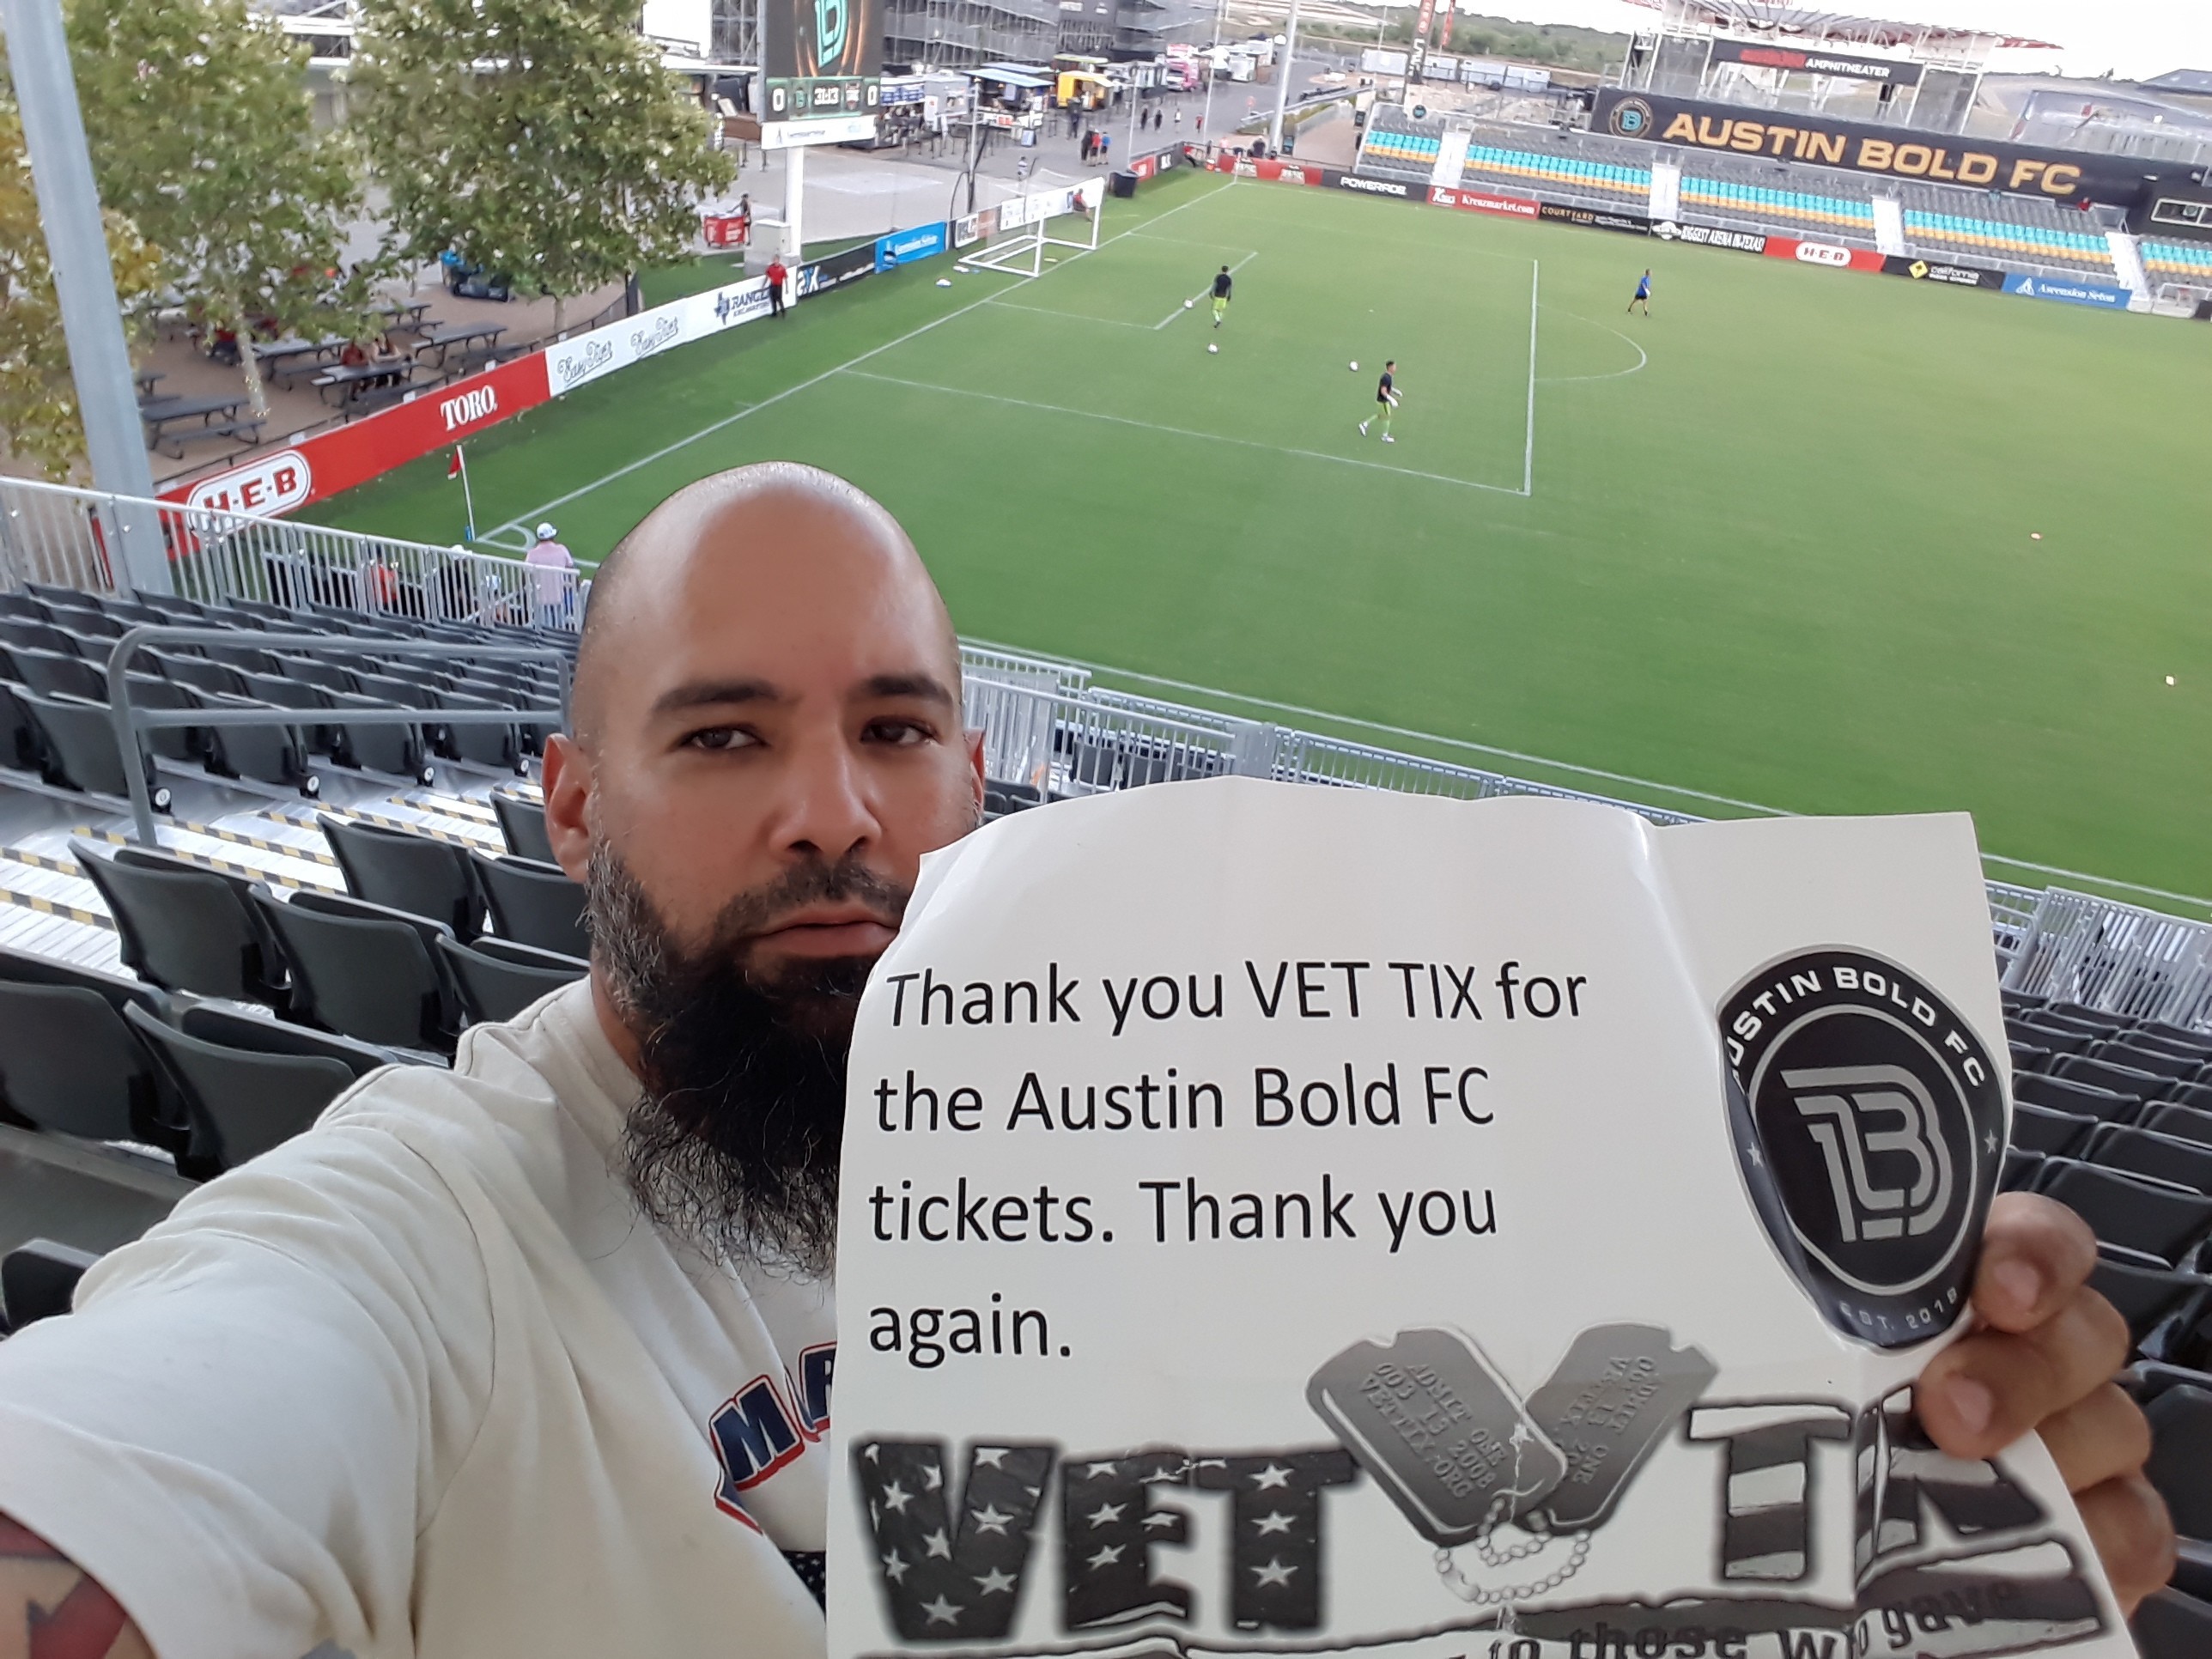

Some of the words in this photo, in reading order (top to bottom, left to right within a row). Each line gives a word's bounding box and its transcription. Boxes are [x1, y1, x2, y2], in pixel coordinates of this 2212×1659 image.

[1662, 112, 1846, 164] AUSTIN
[1856, 137, 1999, 185] BOLD
[2009, 159, 2081, 195] FC
[884, 962, 1081, 1027] Thank
[1102, 974, 1223, 1036] you
[1244, 960, 1370, 1018] VET
[1388, 962, 1482, 1020] TIX
[1495, 961, 1587, 1020] for
[1833, 966, 1936, 1027] BOLD
[1944, 1030, 1984, 1087] FC
[873, 1069, 983, 1132] the
[1006, 1067, 1223, 1131] Austin
[1255, 1062, 1401, 1127] Bold
[1424, 1066, 1494, 1125] FC
[868, 1176, 1113, 1243] tickets.
[1138, 1173, 1357, 1243] Thank
[1378, 1189, 1497, 1254] you
[870, 1292, 1071, 1369] again.
[1405, 1364, 1473, 1426] ADMIT
[1468, 1426, 1510, 1467] ONE
[848, 1439, 1355, 1645] VET
